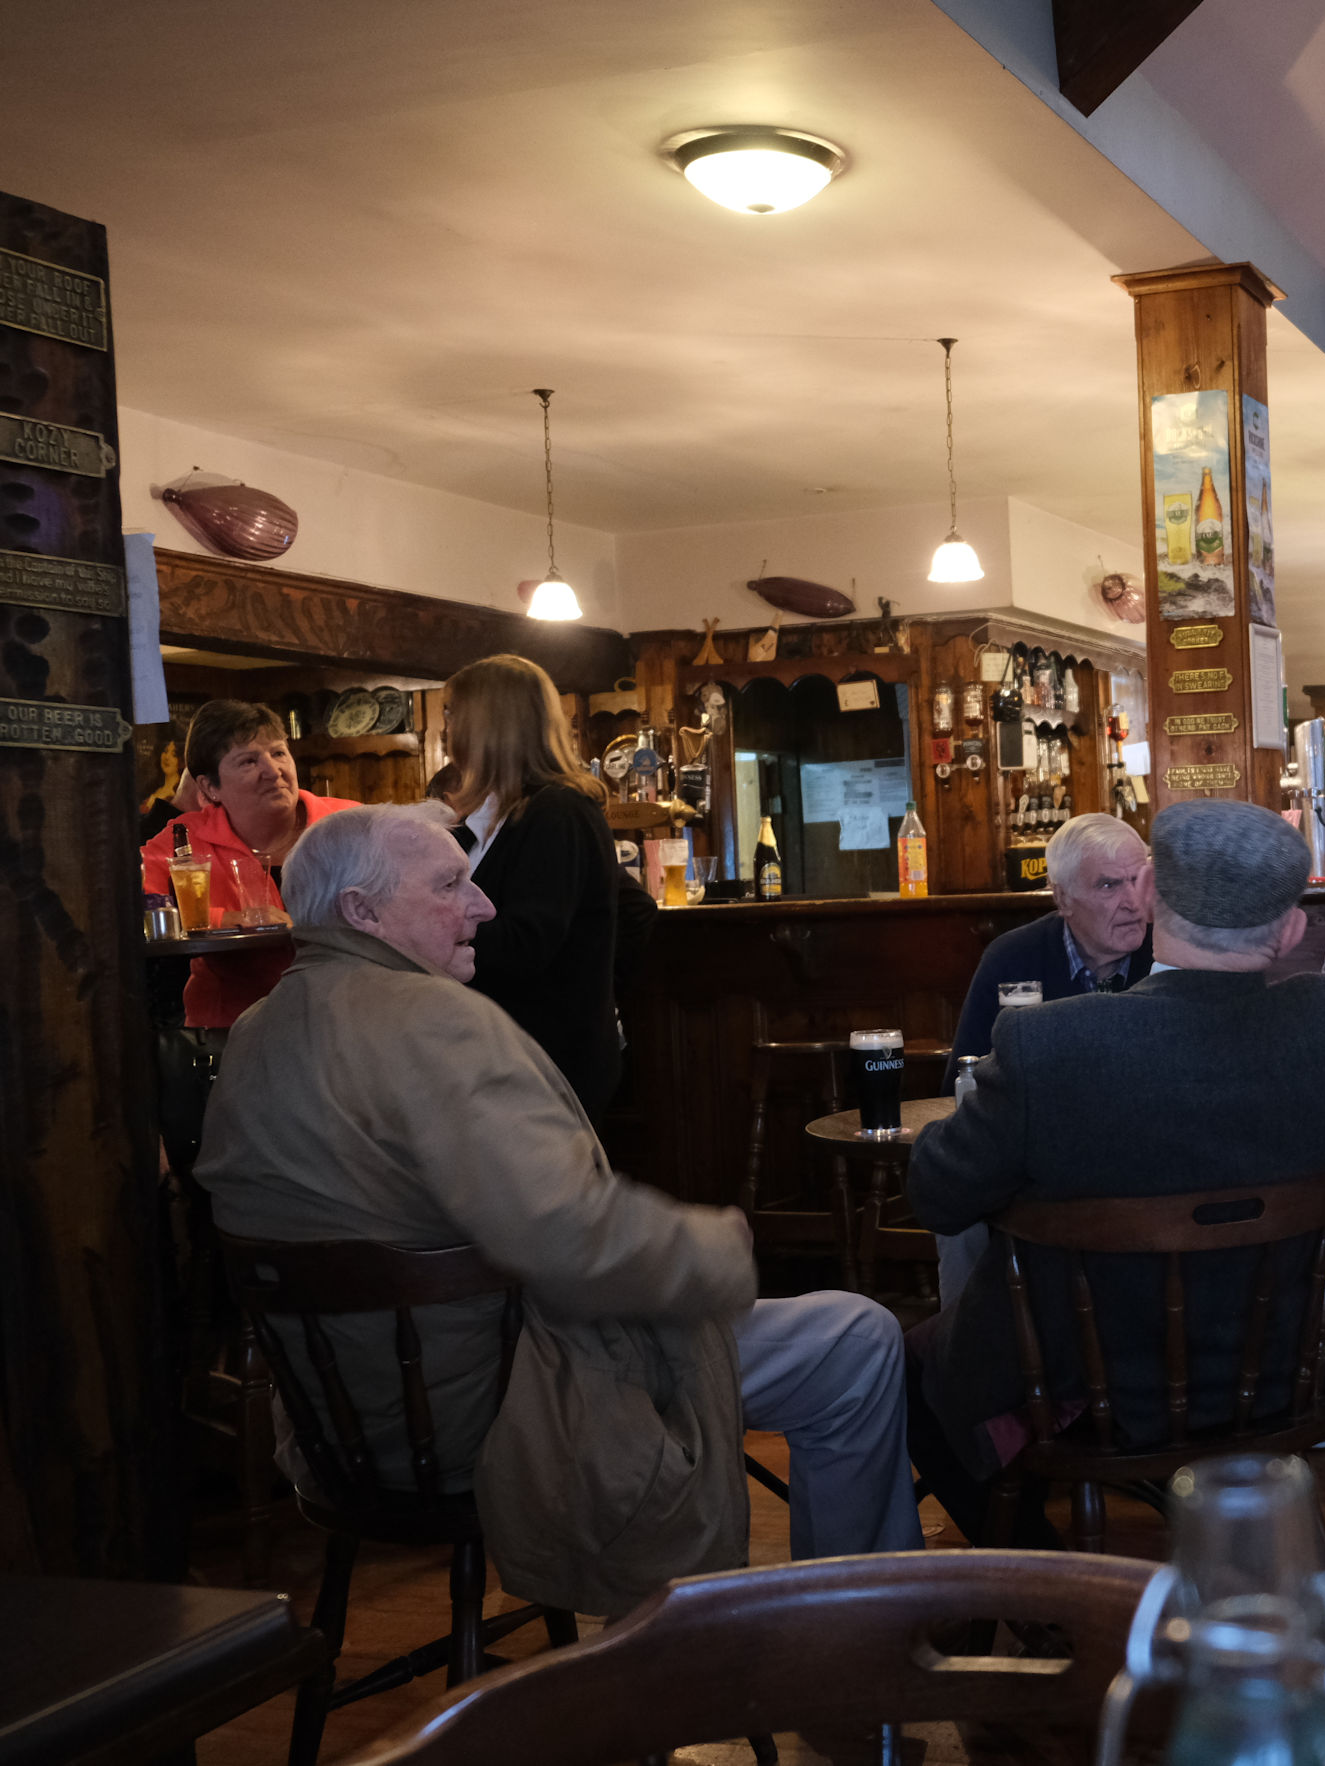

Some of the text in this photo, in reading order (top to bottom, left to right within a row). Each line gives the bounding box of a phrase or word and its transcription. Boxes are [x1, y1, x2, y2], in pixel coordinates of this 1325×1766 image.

[8, 256, 91, 294] YOUR ROOF
[27, 279, 61, 302] FALL
[66, 291, 81, 308] IN
[33, 297, 79, 322] UNDER
[30, 313, 65, 335] FALL
[70, 323, 96, 343] OUT
[23, 421, 71, 447] KOZY
[15, 437, 80, 467] CORNER
[22, 571, 54, 588] have
[8, 704, 104, 728] OUR BEER IS
[0, 723, 113, 745] ROTTEN GOOD
[864, 1058, 904, 1071] GUINNESS
